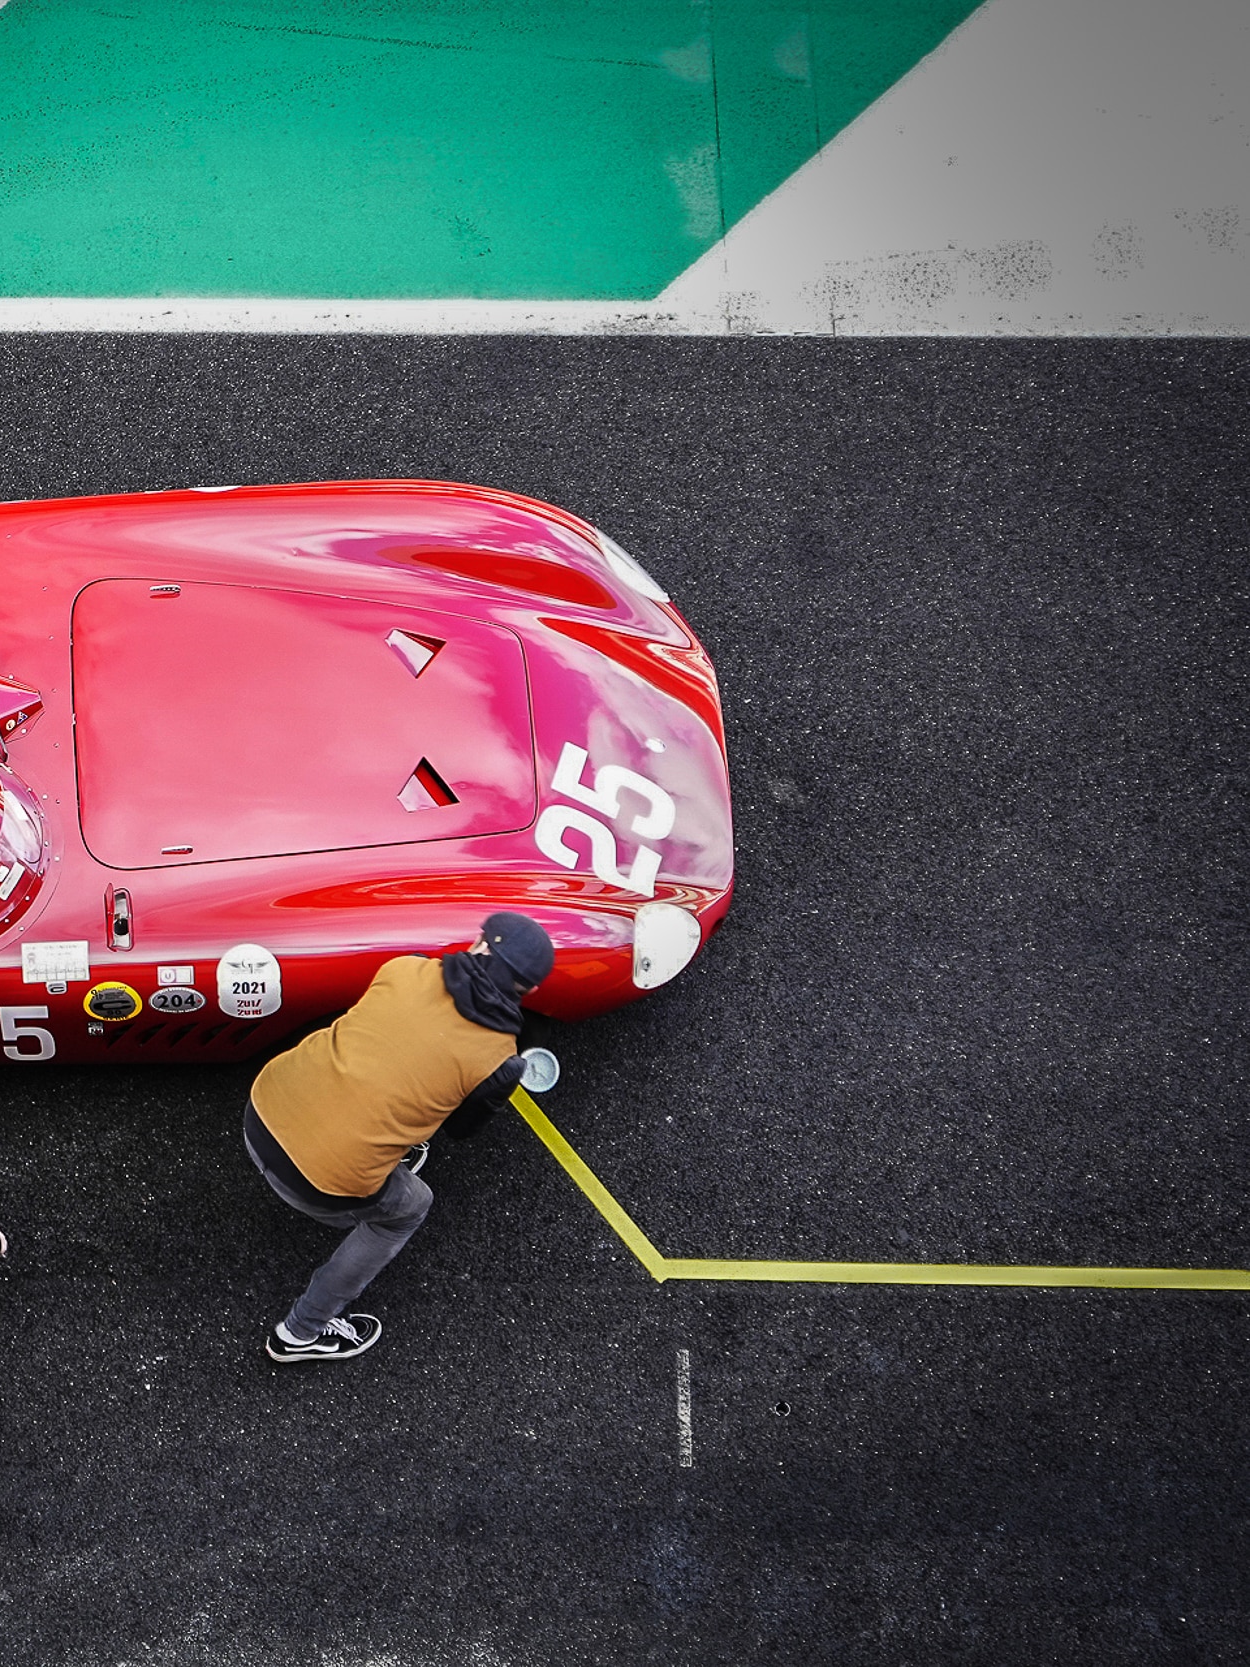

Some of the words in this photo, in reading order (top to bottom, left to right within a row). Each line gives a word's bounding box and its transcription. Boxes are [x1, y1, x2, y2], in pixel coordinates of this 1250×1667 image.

[535, 741, 676, 897] 25
[232, 981, 266, 995] 2021
[157, 994, 196, 1008] 204
